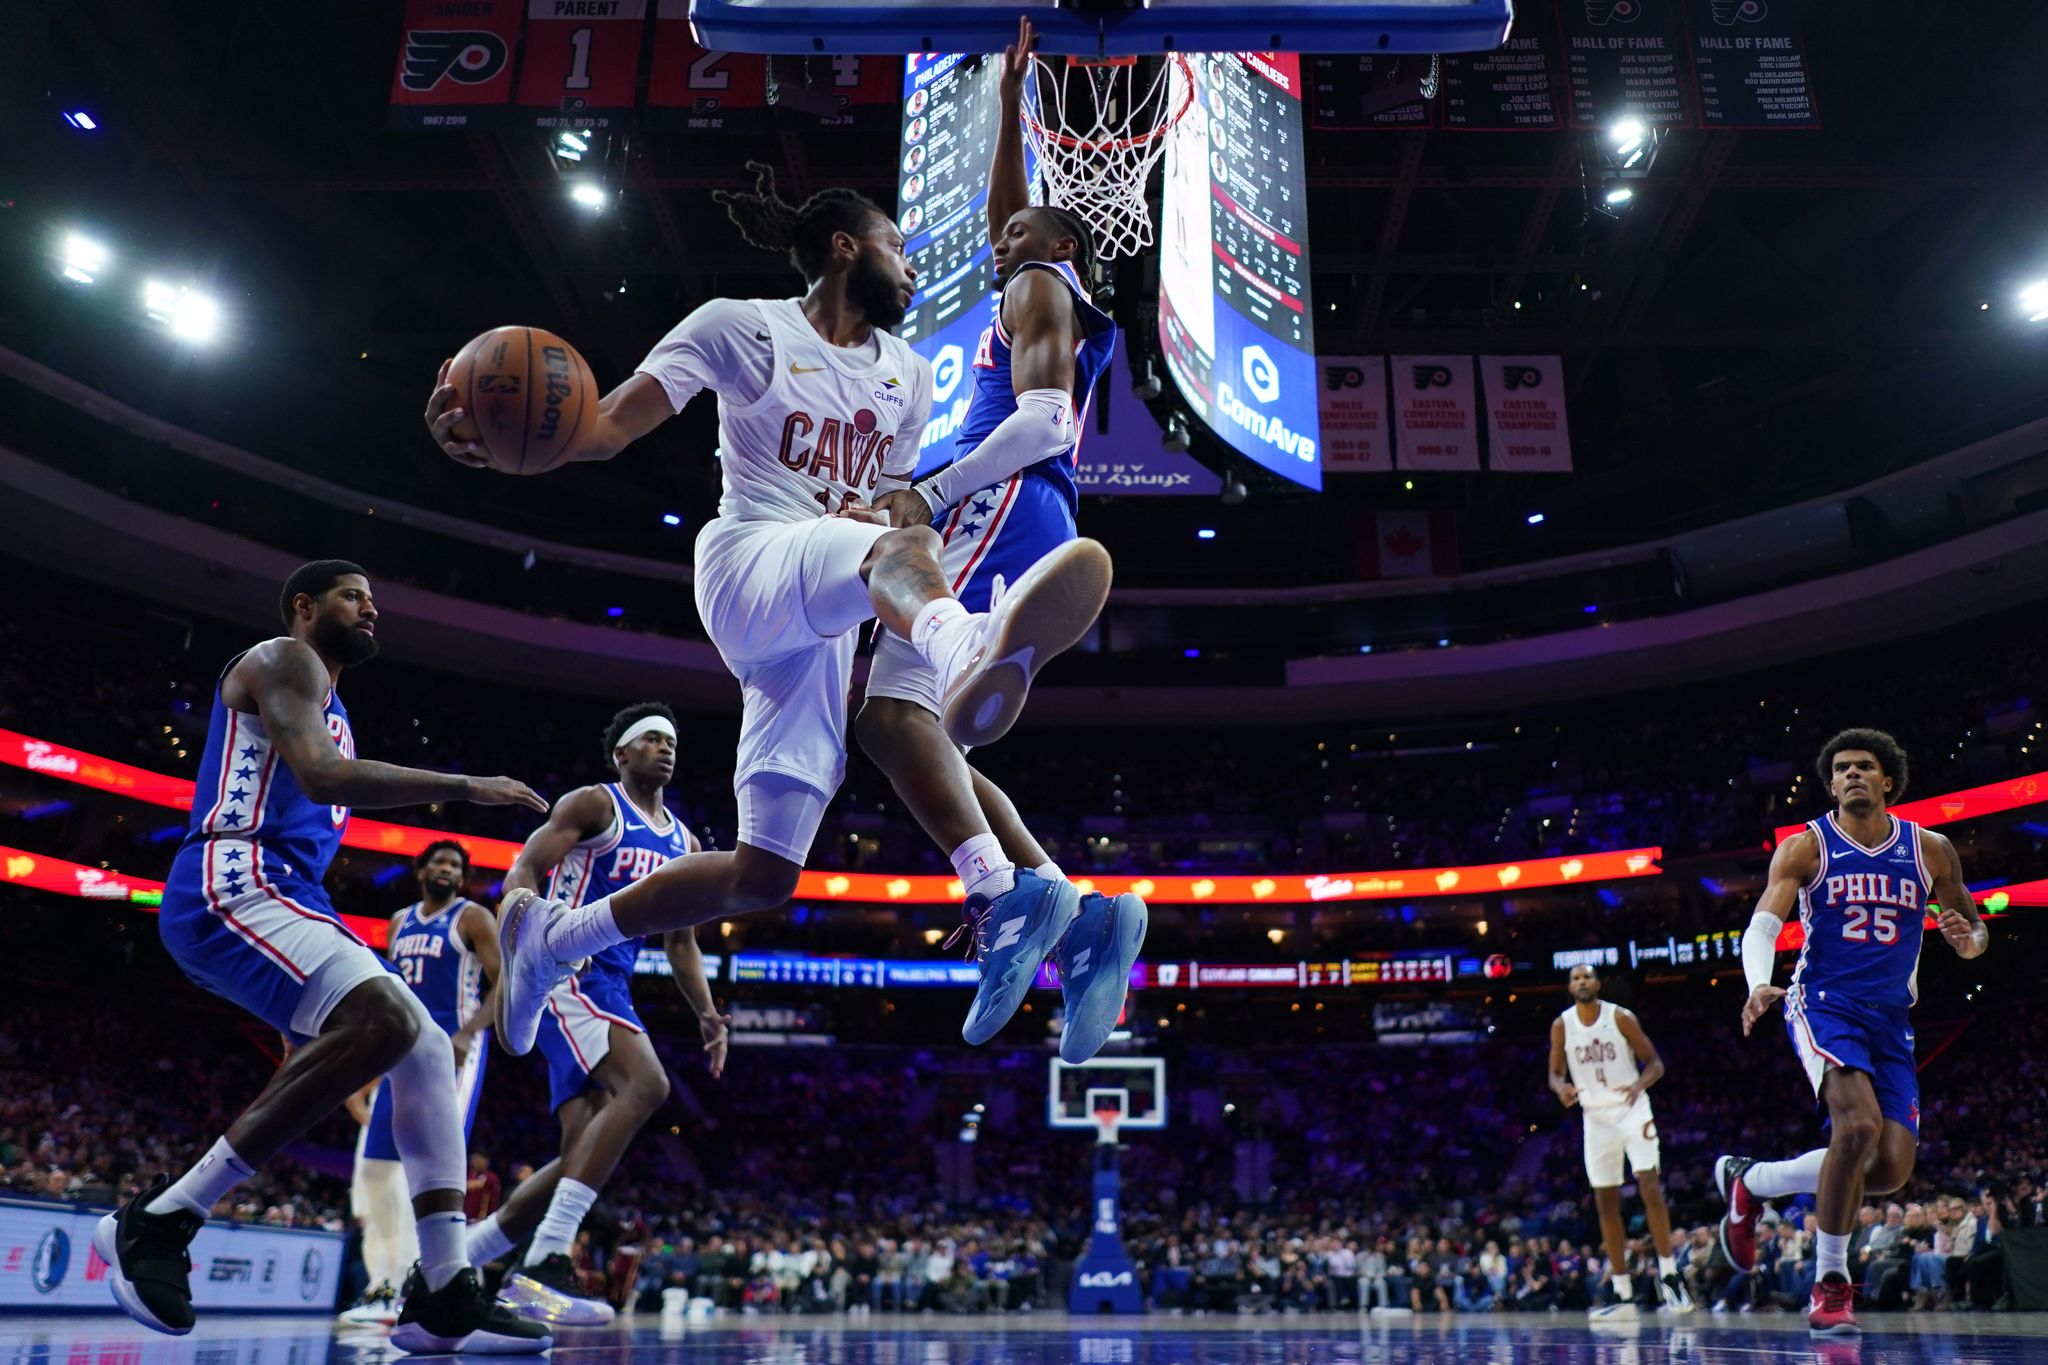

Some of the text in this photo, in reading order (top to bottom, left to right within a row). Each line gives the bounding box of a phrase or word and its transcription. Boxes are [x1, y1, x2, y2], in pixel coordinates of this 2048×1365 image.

[554, 0, 620, 16] PARENT
[1503, 37, 1539, 50] FAME
[1572, 37, 1665, 49] HALL OF FAME
[1700, 37, 1792, 49] HALL OF FAME
[565, 27, 592, 90] 1
[1620, 54, 1673, 63] JOE WATSON
[687, 52, 730, 90] 2
[1247, 52, 1290, 90] CAVALIERS
[1619, 66, 1645, 75] BRIAN
[1625, 78, 1651, 86] MARK
[1625, 89, 1646, 98] DAVE
[1514, 116, 1530, 124] TIM
[538, 346, 572, 440] Wilson
[874, 391, 904, 407] CLIFFS
[1330, 401, 1363, 410] WALES
[1412, 400, 1456, 409] EASTERN
[1503, 401, 1547, 409] EASTERN
[1319, 411, 1378, 420] CONFERENCE
[1403, 410, 1466, 420] CONFERENCE
[1495, 411, 1558, 420] CONFERENCE
[1217, 381, 1316, 463] ComAve
[1320, 421, 1377, 430] CHAMPIONS
[1406, 420, 1465, 430] CHAMPIONS
[1498, 421, 1557, 430] CHAMPIONS
[778, 410, 895, 490] CAVS
[1079, 464, 1144, 473] AREN
[1106, 473, 1191, 487] xfinity
[1826, 873, 1919, 910] PHILA
[1842, 905, 1899, 945] 25
[392, 934, 444, 962] PHILA
[399, 956, 424, 984] 21
[1575, 1040, 1616, 1064] CAVS
[1596, 1068, 1608, 1088] 4
